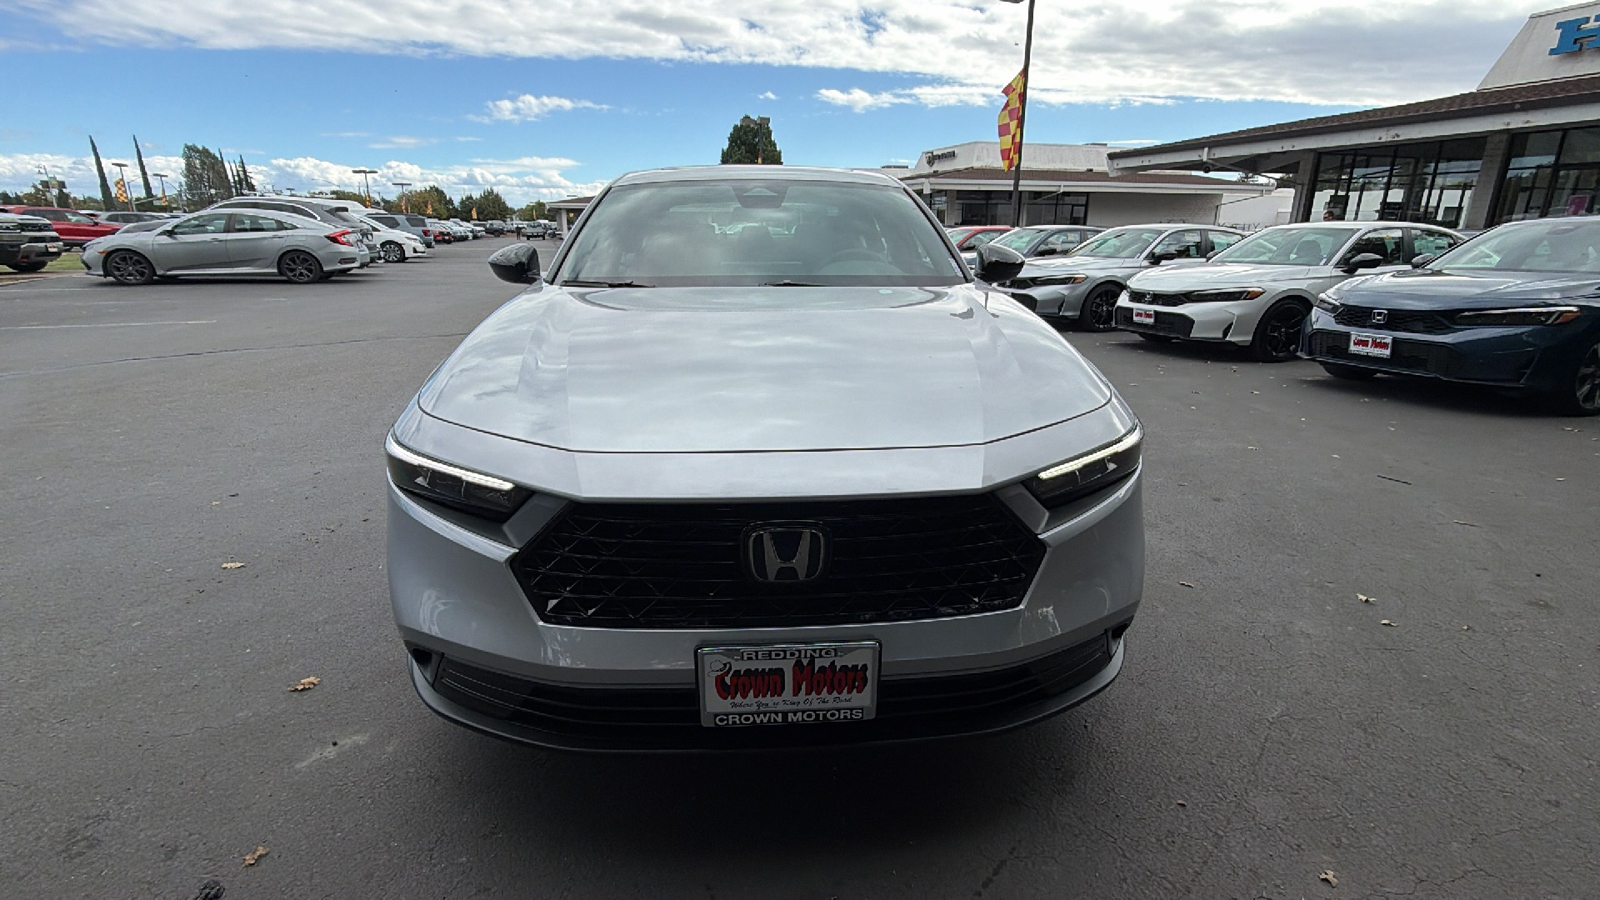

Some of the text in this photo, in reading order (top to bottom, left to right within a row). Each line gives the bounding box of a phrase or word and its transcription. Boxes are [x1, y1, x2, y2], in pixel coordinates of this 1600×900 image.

[743, 649, 835, 660] REDDING
[714, 659, 868, 700] Crown Motors
[715, 709, 863, 726] CROWN MOTORS
